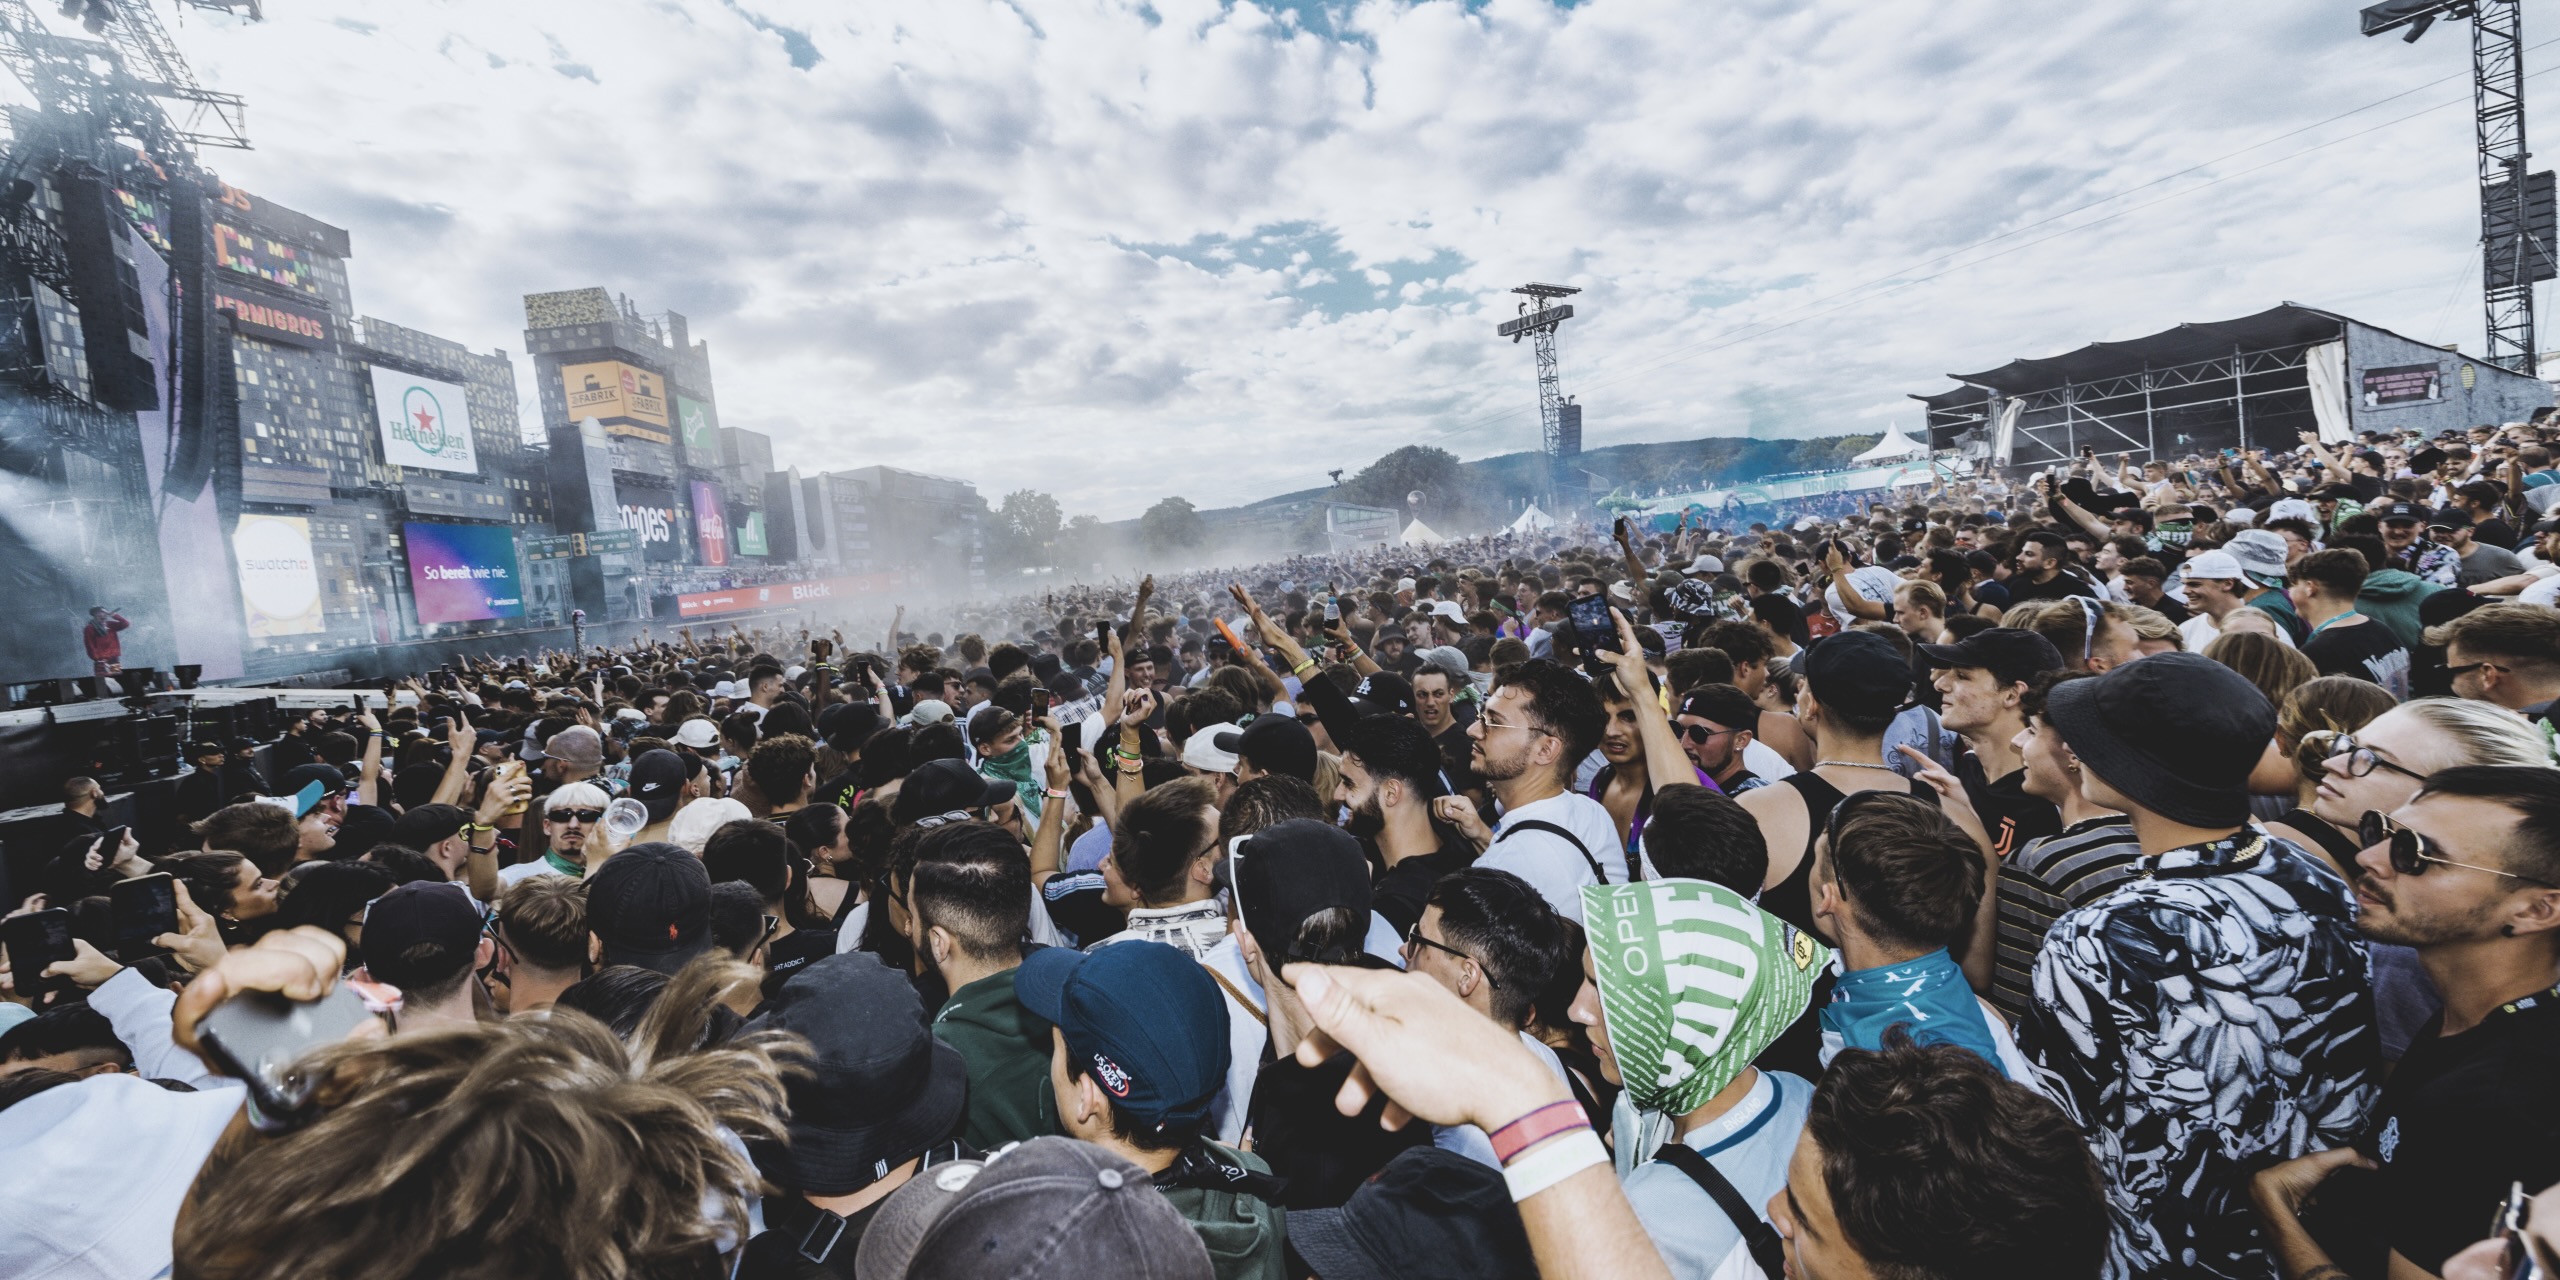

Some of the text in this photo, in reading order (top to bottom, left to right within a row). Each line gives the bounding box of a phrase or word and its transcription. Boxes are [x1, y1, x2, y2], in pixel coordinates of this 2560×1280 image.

[578, 389, 616, 403] FABRIK
[389, 421, 466, 450] Heineken
[1802, 476, 1849, 494] DRINKS
[617, 504, 670, 549] nipes
[245, 557, 299, 571] swatch
[424, 565, 439, 580] So
[439, 564, 472, 580] bereit
[472, 565, 491, 579] wie
[792, 582, 831, 600] Blick
[1612, 884, 1649, 976] OPEN
[784, 956, 805, 968] ADDICT
[1103, 1064, 1126, 1091] OPEN
[1722, 1097, 1762, 1131] ENGLAND
